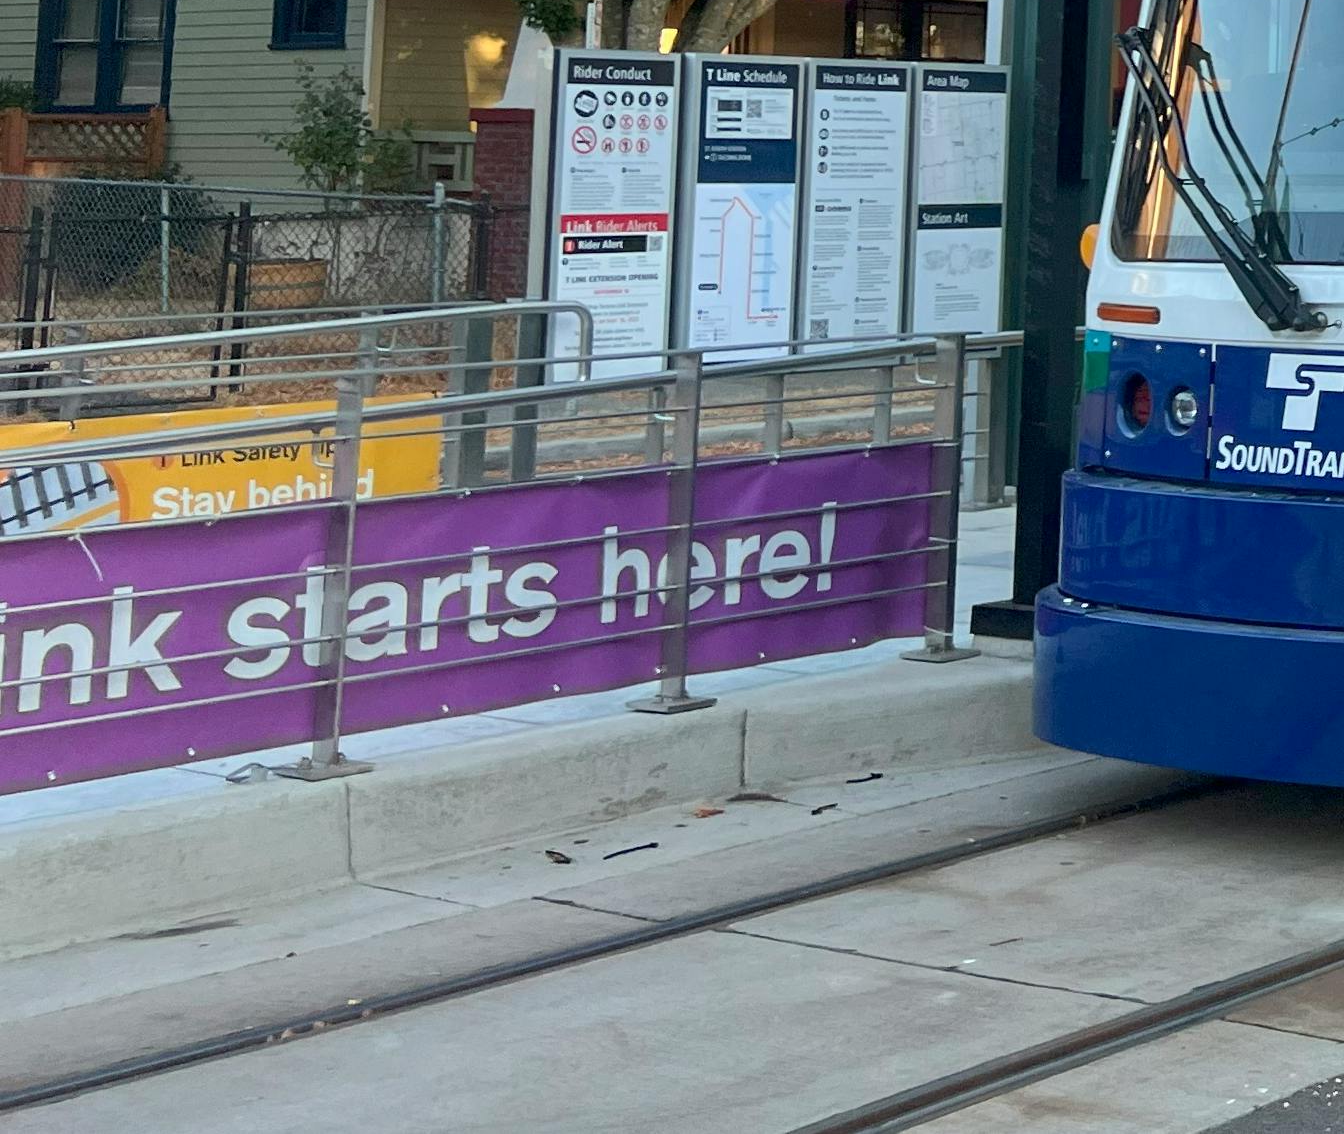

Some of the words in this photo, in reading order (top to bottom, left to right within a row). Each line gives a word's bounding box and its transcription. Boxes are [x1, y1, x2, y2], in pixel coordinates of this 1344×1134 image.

[574, 65, 602, 79] Rider
[606, 66, 652, 81] Conduct
[706, 68, 713, 80] T
[716, 69, 741, 82] Line
[743, 70, 788, 84] Schedule
[823, 73, 847, 84] How
[856, 73, 876, 85] Ride
[877, 74, 900, 86] Link
[926, 75, 948, 87] Area
[950, 76, 970, 90] Map
[921, 213, 952, 224] Station
[953, 212, 969, 223] Art
[566, 219, 593, 233] Link
[577, 240, 600, 250] Rider
[151, 486, 236, 520] Stay
[248, 468, 375, 509] behid
[223, 546, 559, 681] starts
[600, 501, 838, 624] here!
